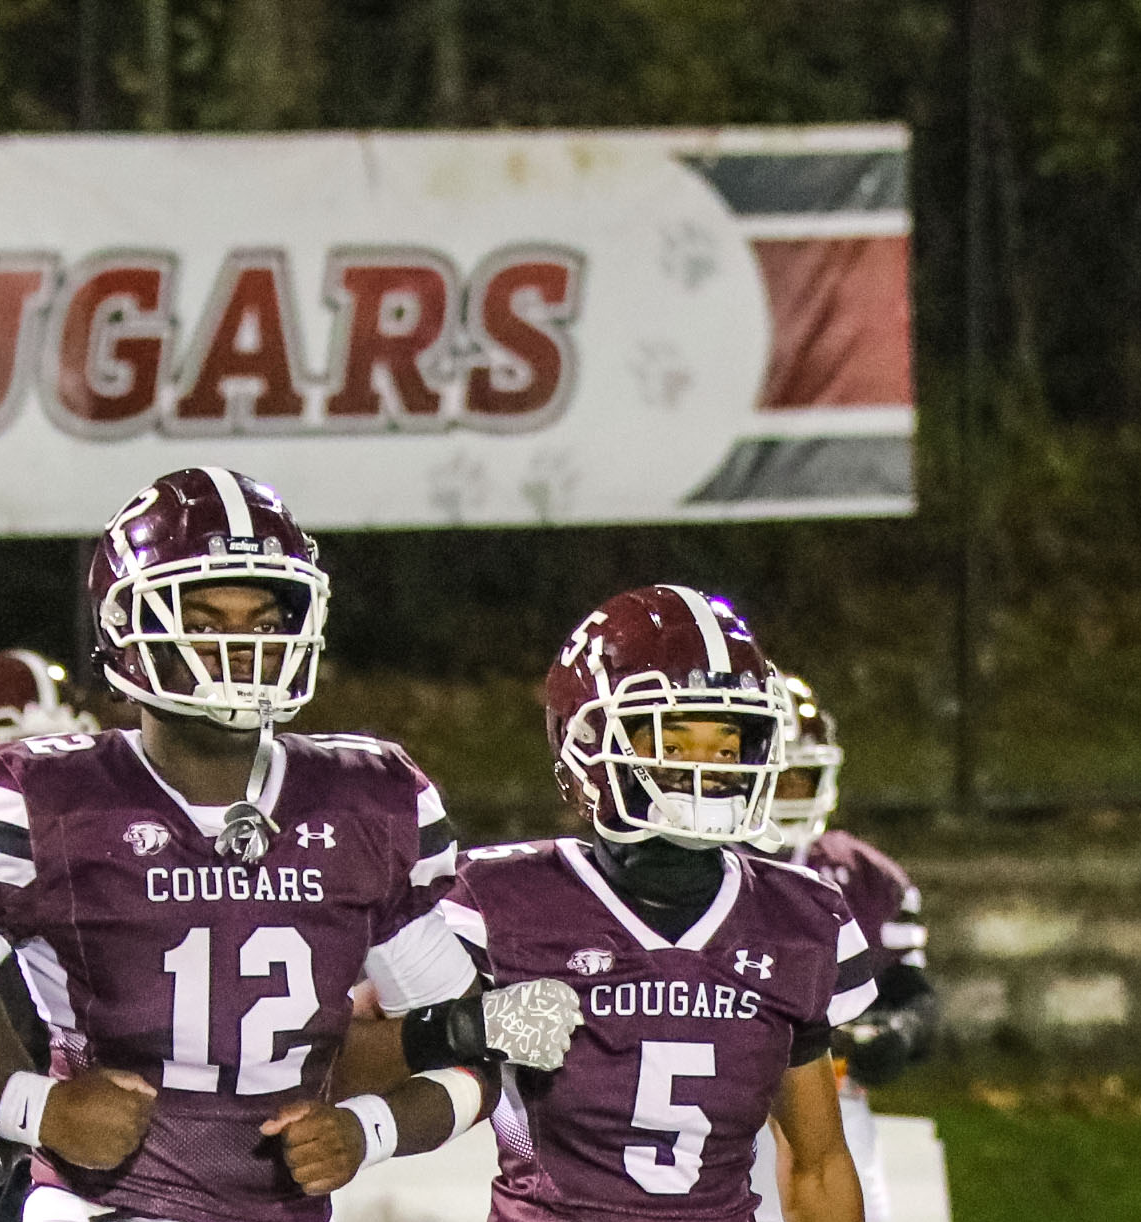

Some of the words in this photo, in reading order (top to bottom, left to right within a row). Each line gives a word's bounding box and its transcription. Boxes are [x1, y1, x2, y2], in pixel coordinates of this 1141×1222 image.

[146, 867, 324, 903] COUGARS
[162, 926, 321, 1096] 12
[589, 981, 761, 1020] COUGARS
[623, 1041, 717, 1196] 5
